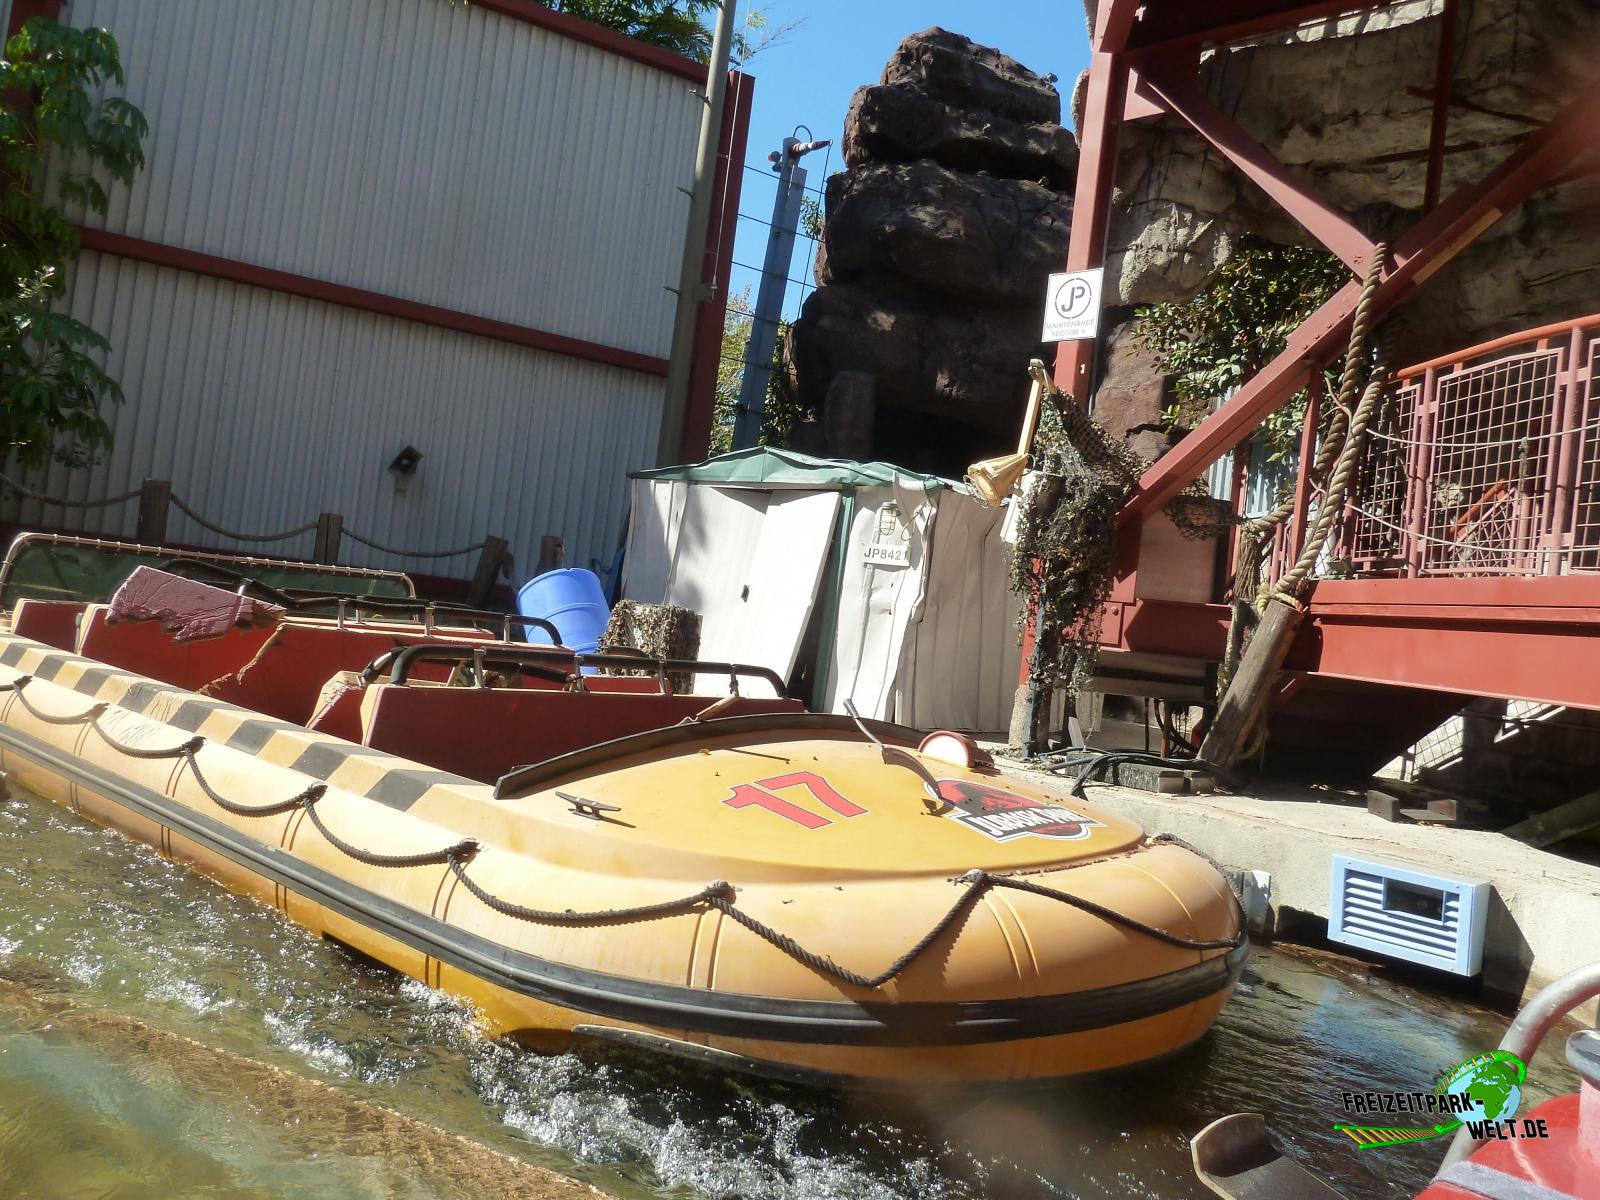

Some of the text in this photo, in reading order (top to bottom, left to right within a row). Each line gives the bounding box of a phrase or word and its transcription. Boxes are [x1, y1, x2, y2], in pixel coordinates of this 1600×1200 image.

[1061, 286, 1086, 312] JP
[1046, 319, 1095, 329] MAINTENANCE
[721, 771, 870, 829] 17
